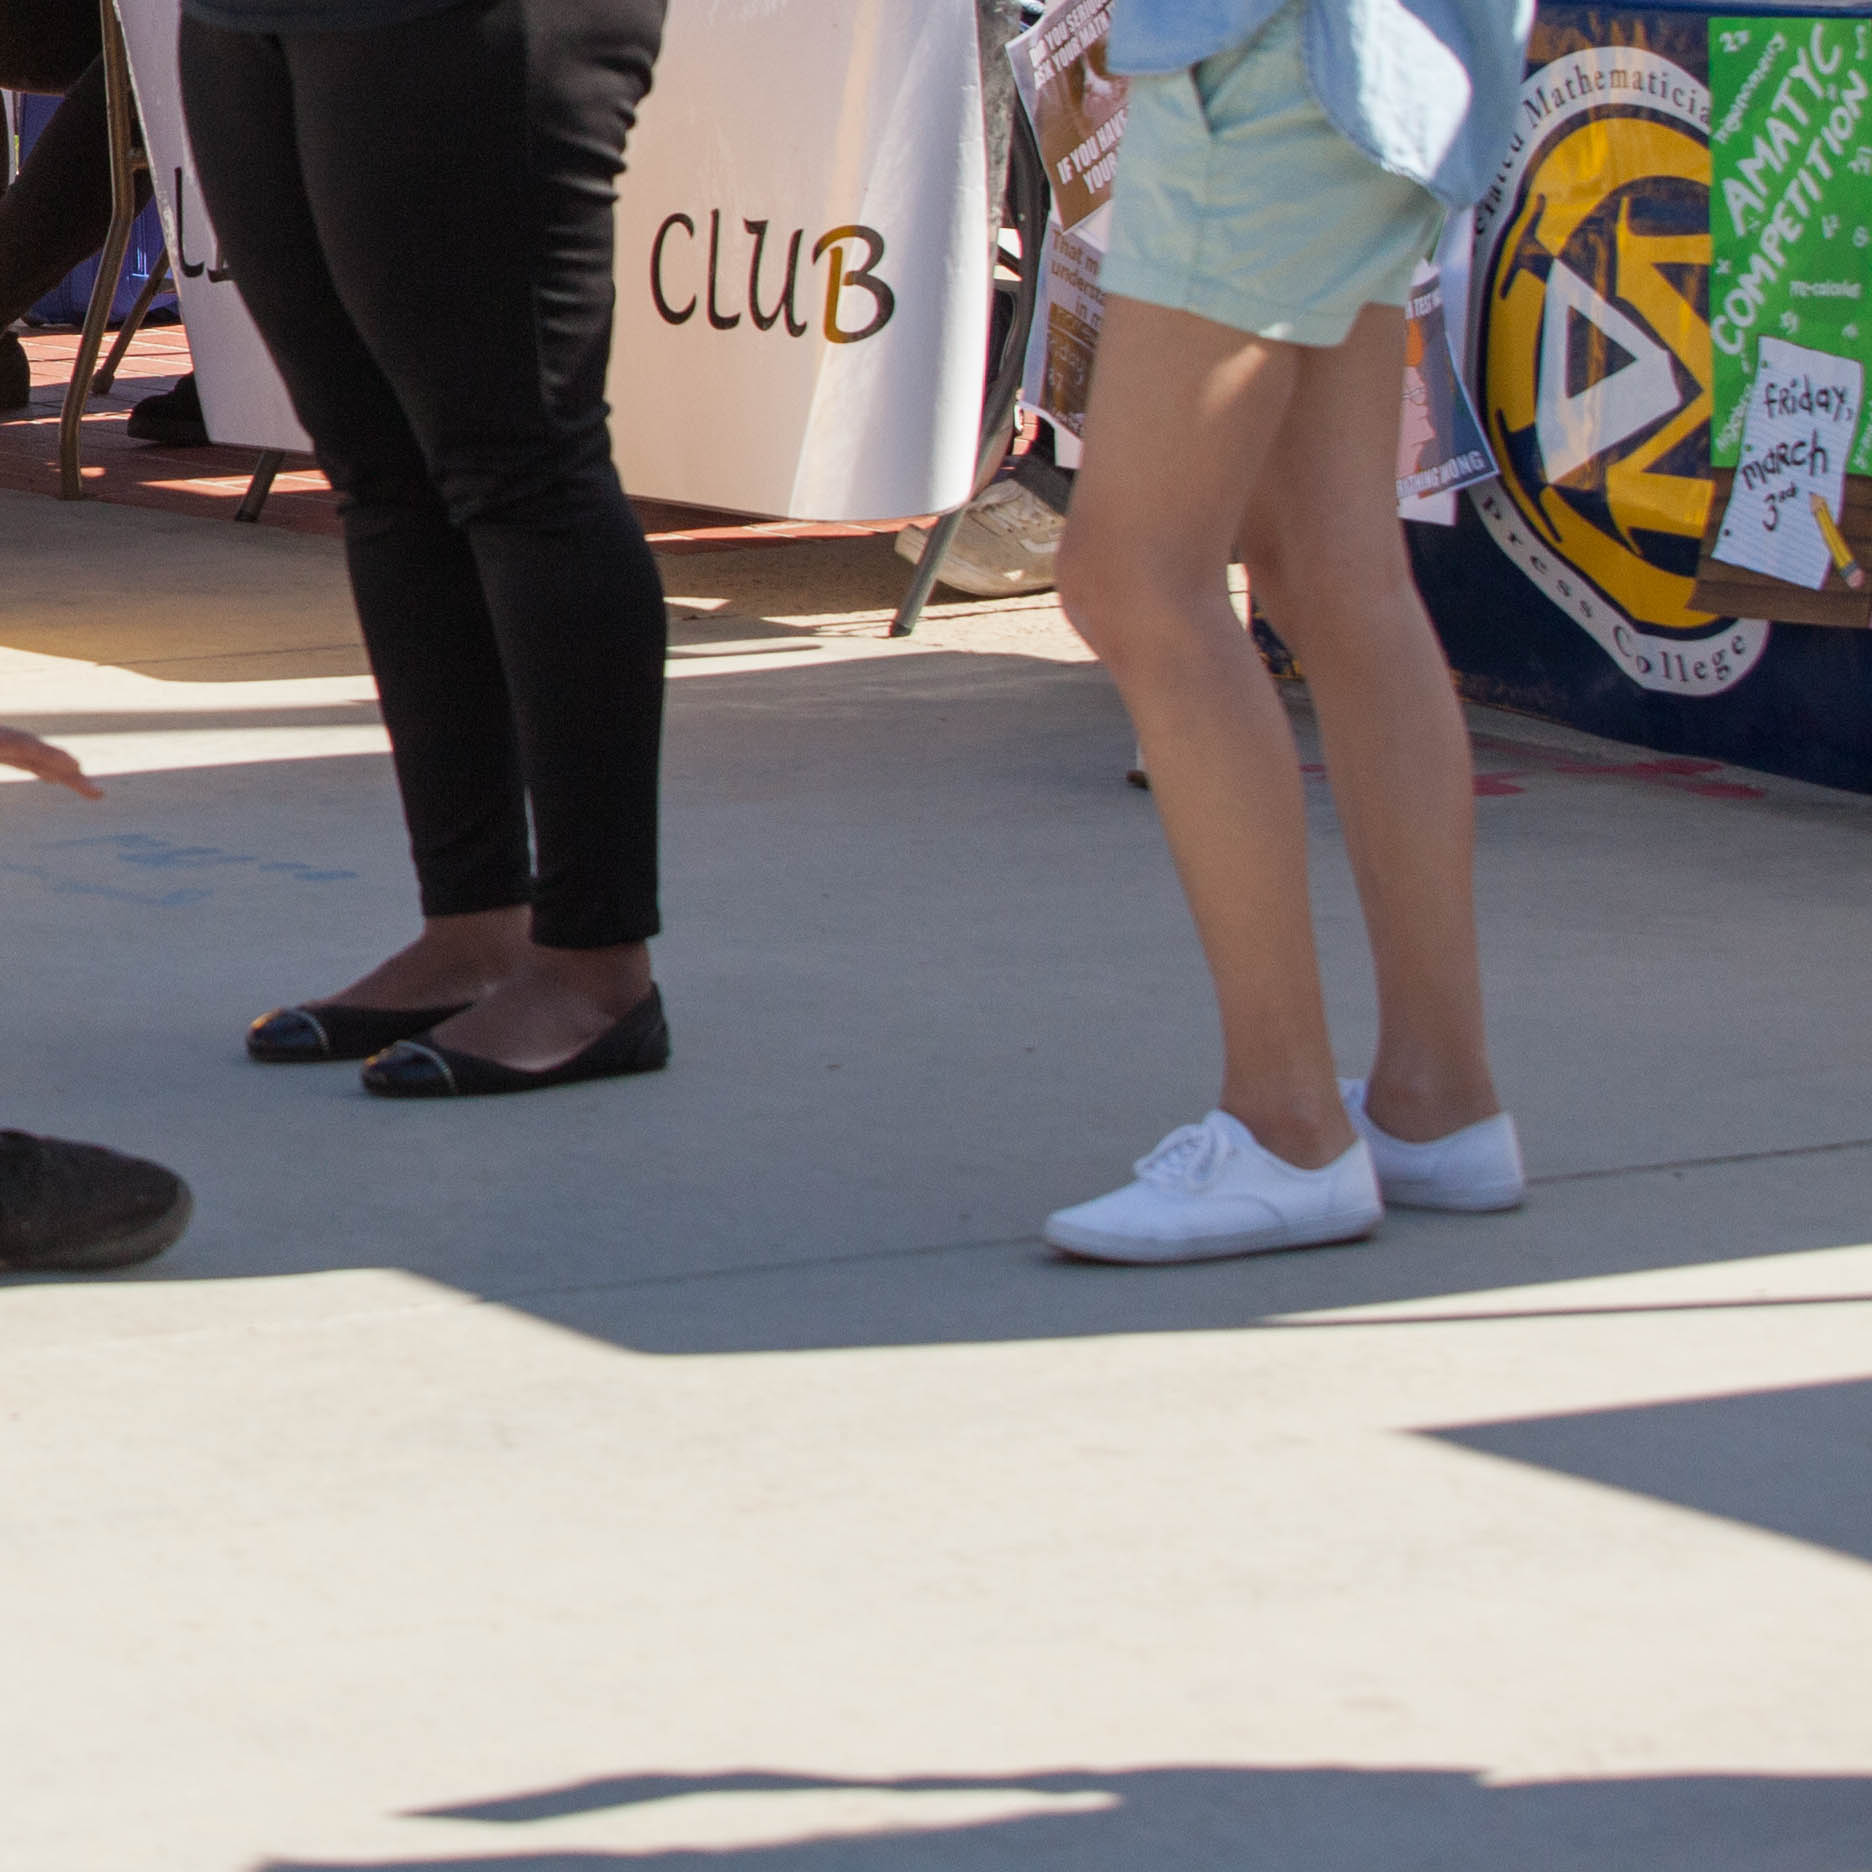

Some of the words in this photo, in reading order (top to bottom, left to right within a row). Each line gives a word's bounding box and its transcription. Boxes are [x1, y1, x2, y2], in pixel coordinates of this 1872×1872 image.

[1070, 136, 1101, 173] YOU
[1721, 22, 1843, 238] AMATYC
[1710, 69, 1869, 356] COMPETITION
[1611, 624, 1747, 683] College
